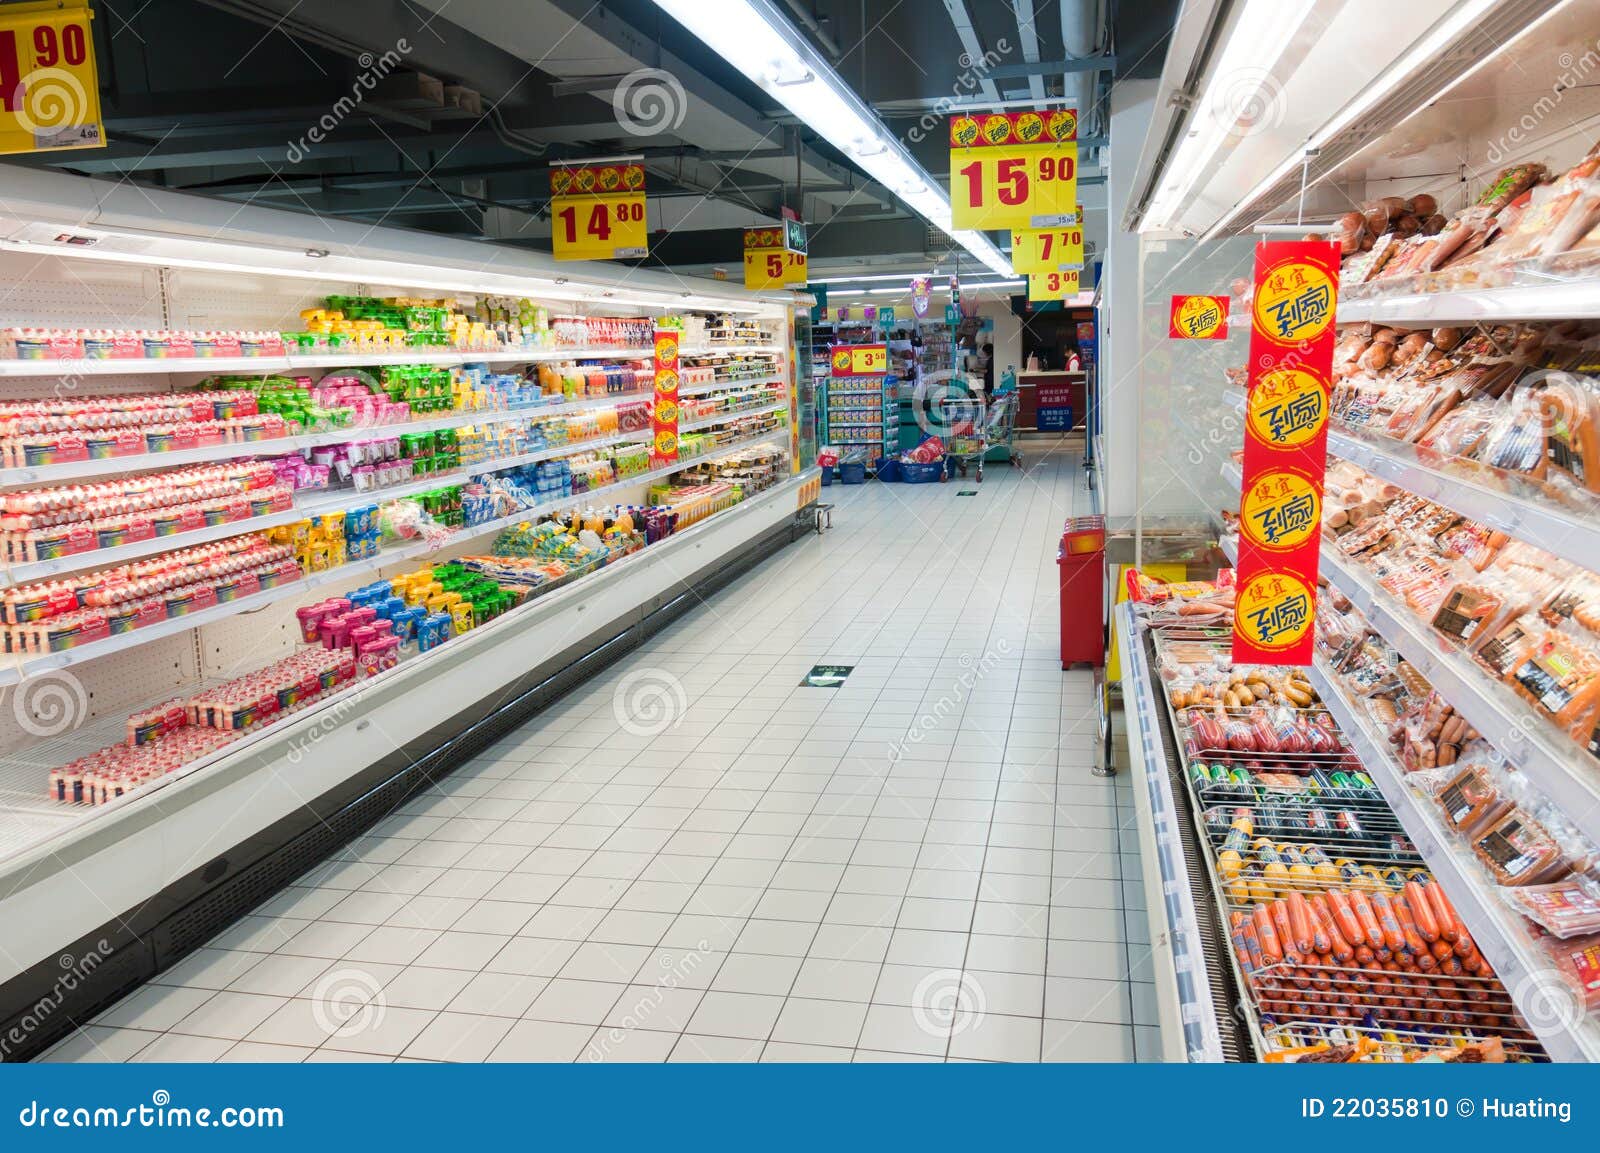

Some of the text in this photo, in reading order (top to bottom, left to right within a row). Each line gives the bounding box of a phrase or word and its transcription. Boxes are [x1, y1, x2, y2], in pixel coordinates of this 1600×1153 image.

[1269, 268, 1308, 294] 便宜
[1266, 285, 1329, 337] 到家
[1260, 373, 1302, 399] 便宜
[1259, 390, 1321, 442] 到家
[1255, 477, 1294, 502] 便宜
[1253, 493, 1314, 543] 到家
[1248, 577, 1289, 601] 便宜
[1247, 596, 1307, 642] 到家
